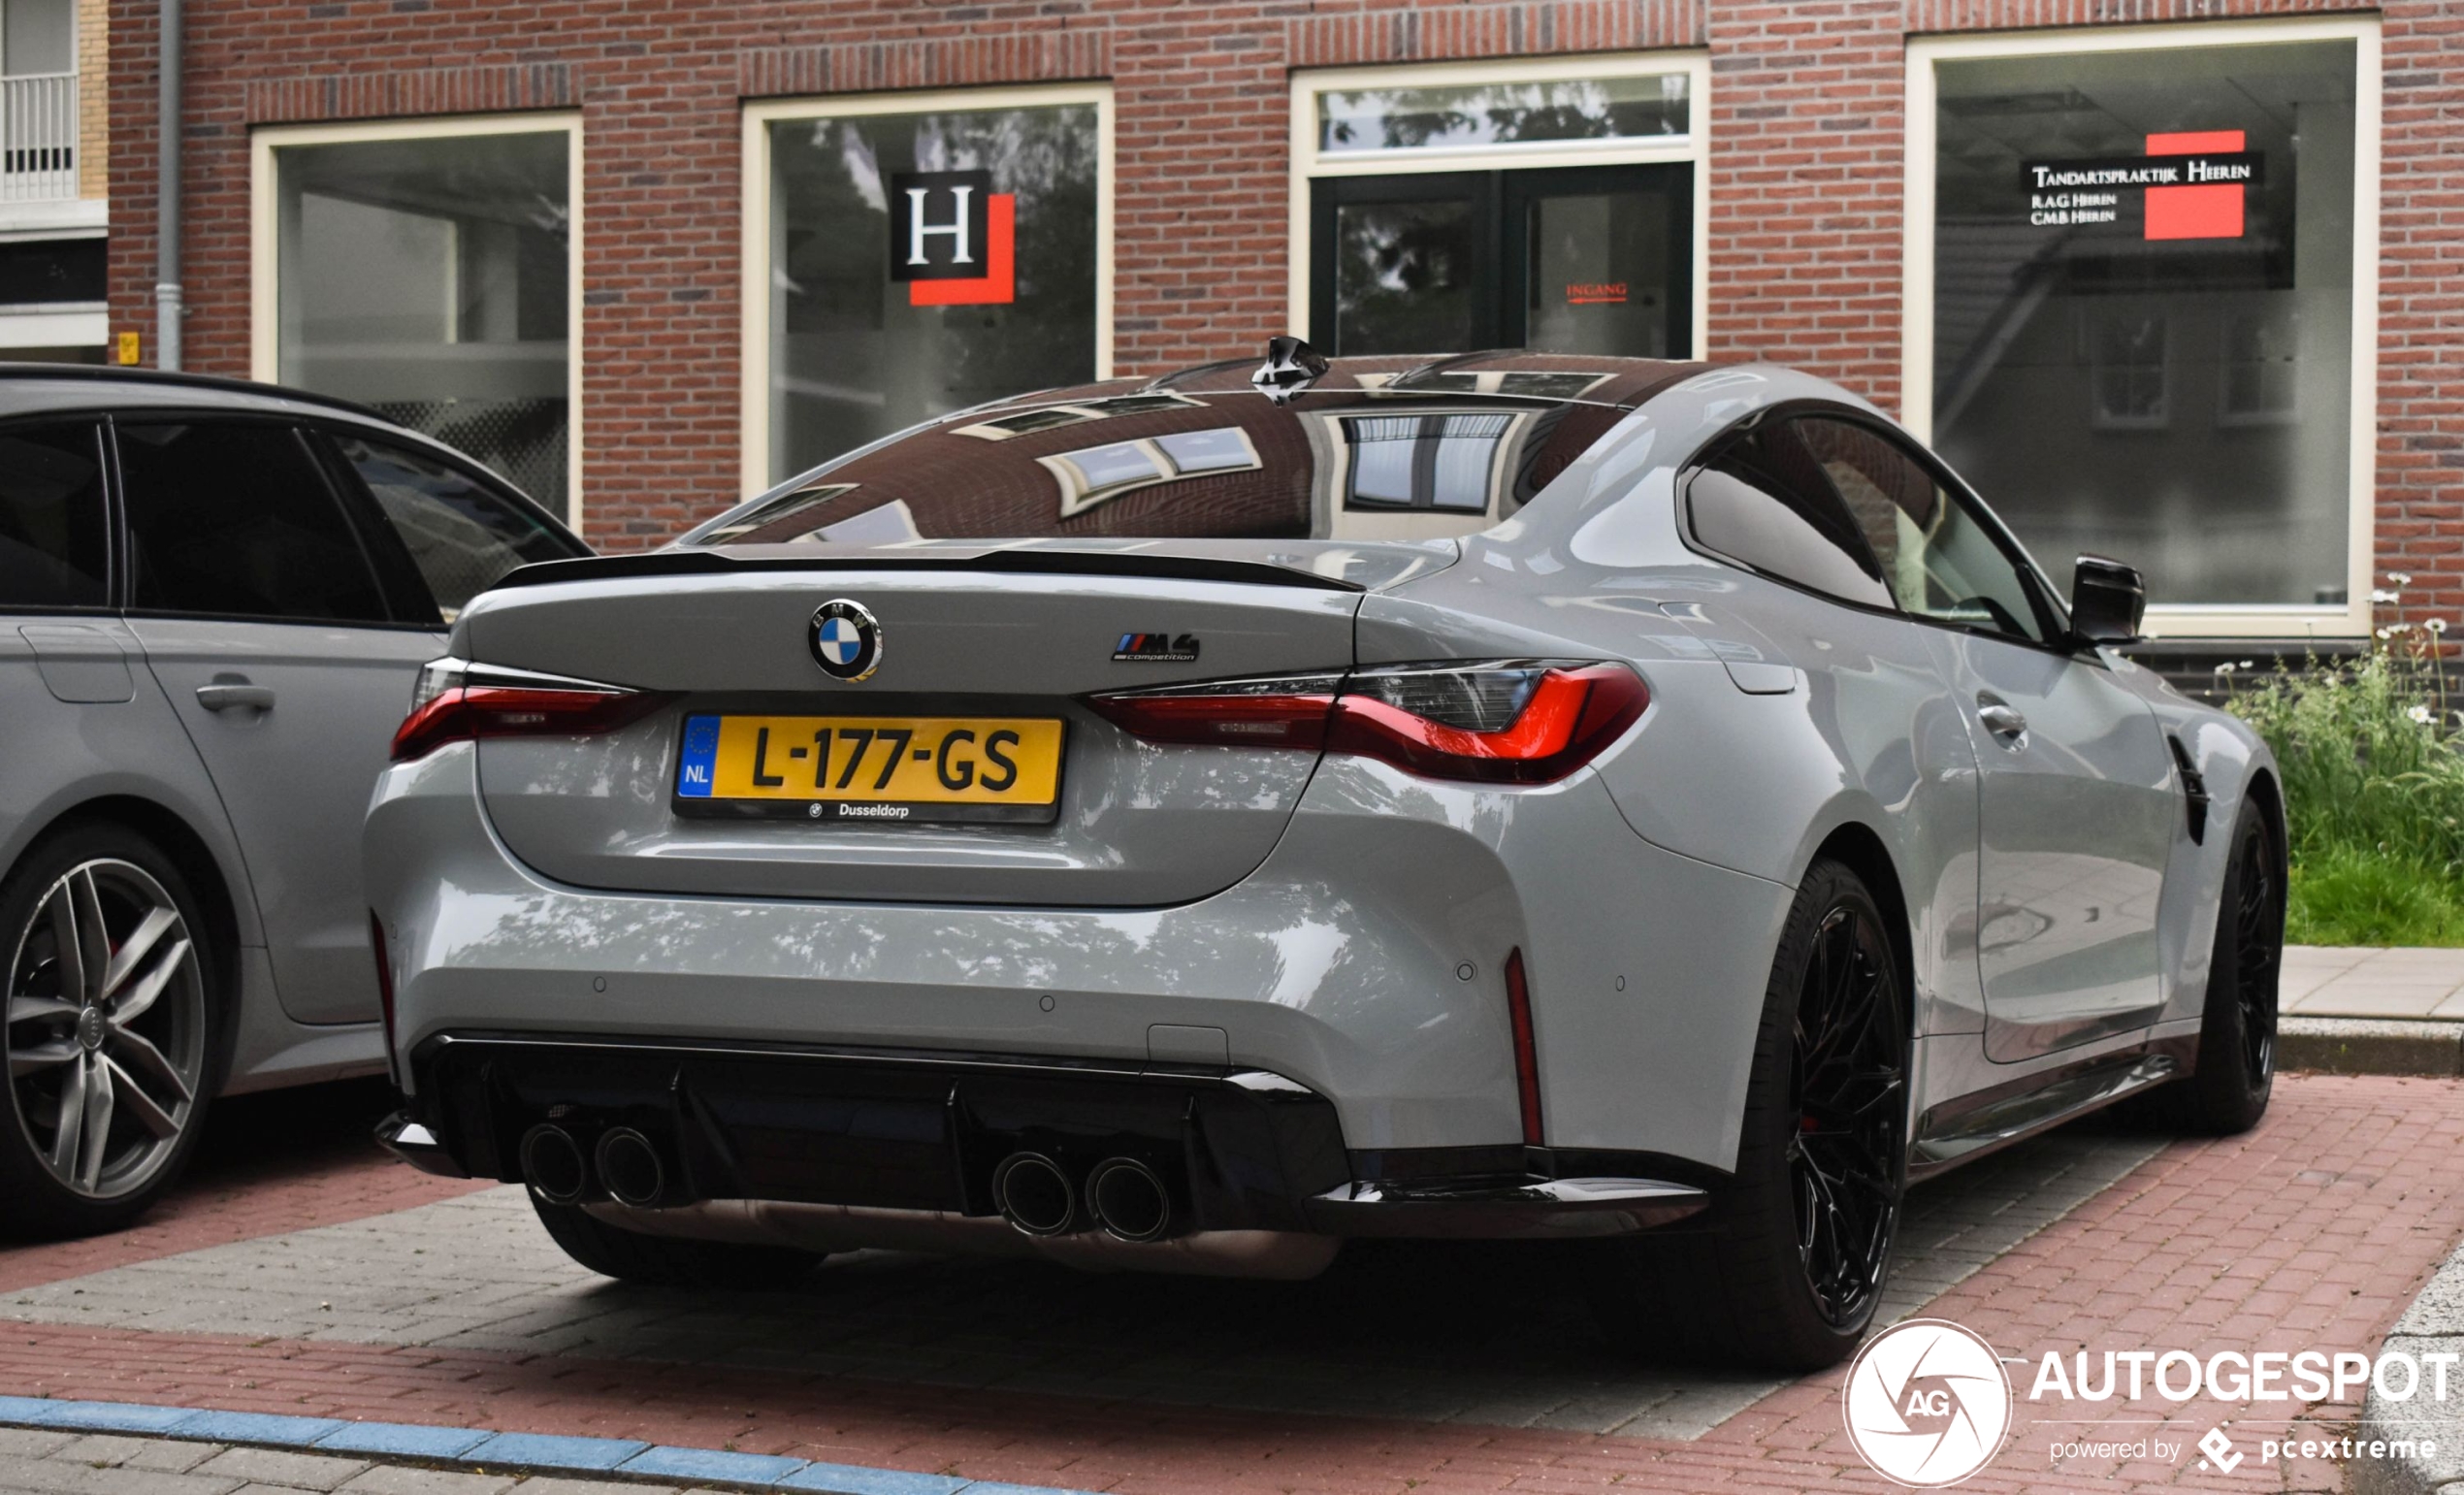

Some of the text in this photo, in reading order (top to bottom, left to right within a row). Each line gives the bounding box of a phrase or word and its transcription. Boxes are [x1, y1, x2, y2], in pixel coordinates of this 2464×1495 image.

[905, 184, 974, 265] H
[1566, 282, 1627, 296] INGANG
[813, 603, 868, 629] BMW
[1126, 653, 1195, 662] competition
[753, 727, 1020, 792] L-177-GS
[685, 764, 709, 784] NL
[839, 803, 910, 820] Dusseldorp
